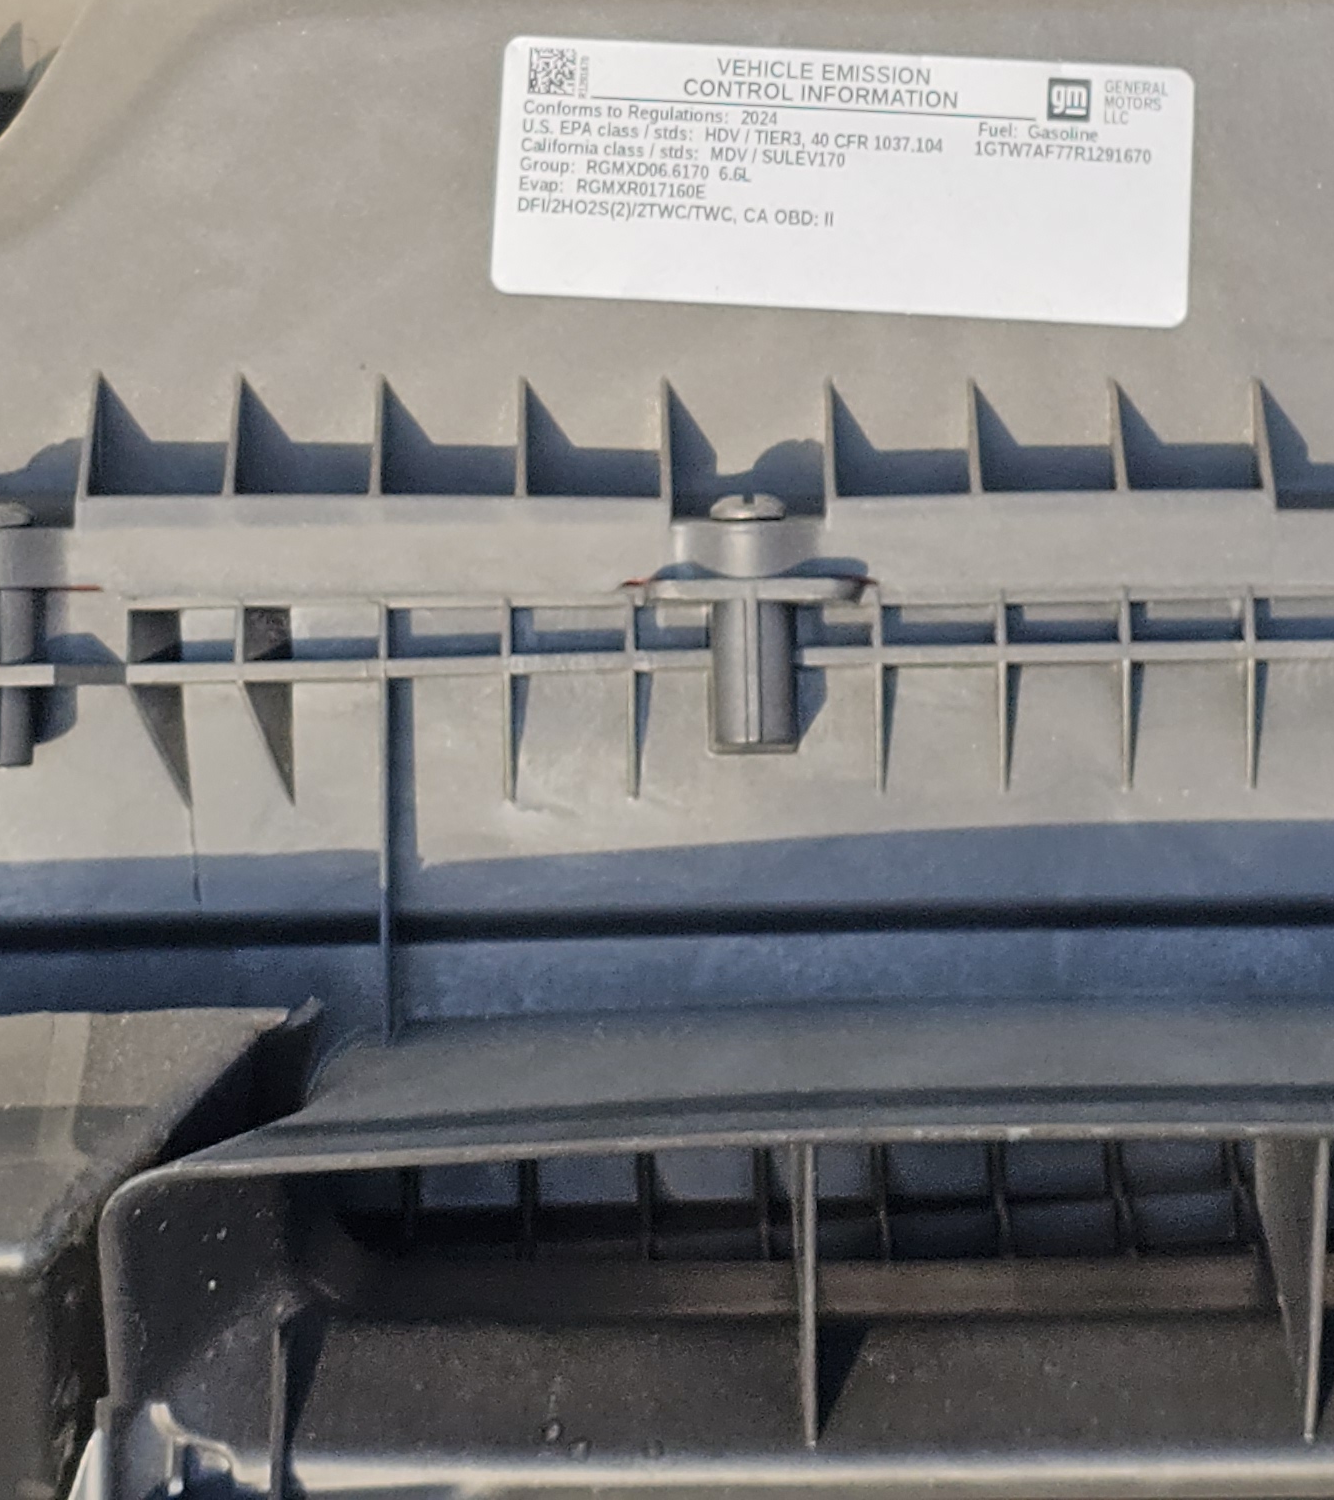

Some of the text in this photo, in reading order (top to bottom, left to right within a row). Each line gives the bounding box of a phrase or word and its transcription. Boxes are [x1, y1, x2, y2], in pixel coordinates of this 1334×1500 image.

[718, 58, 931, 86] VEHICLE EMISSION
[683, 78, 959, 110] CONTROL INFORMATION
[1050, 84, 1088, 116] gm
[1104, 80, 1168, 97] GENERAL
[523, 100, 778, 126] Conforms to Regulations: 2024
[1104, 96, 1163, 111] MOTORS
[1104, 110, 1130, 125] LLC
[523, 118, 554, 135] U.S.
[560, 120, 592, 136] EPA
[597, 122, 639, 138] class
[654, 125, 693, 142] stds:
[705, 128, 741, 143] HDV
[755, 129, 806, 148] TIER3,
[811, 133, 829, 147] 40
[834, 133, 868, 150] CFR
[874, 135, 944, 153] 1037.104
[978, 122, 1098, 143] Fuel: Gasoline
[521, 137, 598, 156] California
[603, 141, 644, 157] class
[660, 145, 699, 161] stds:
[710, 147, 748, 163] MDV
[761, 149, 846, 168] SULEV170
[974, 141, 1152, 165] 1GTW7AF77R1291670
[519, 156, 752, 182] Group: RGMXD06.6170 6.6L
[518, 175, 707, 199] Evap: RGMXR017160E
[743, 207, 768, 224] CA
[774, 209, 819, 227] OBD:
